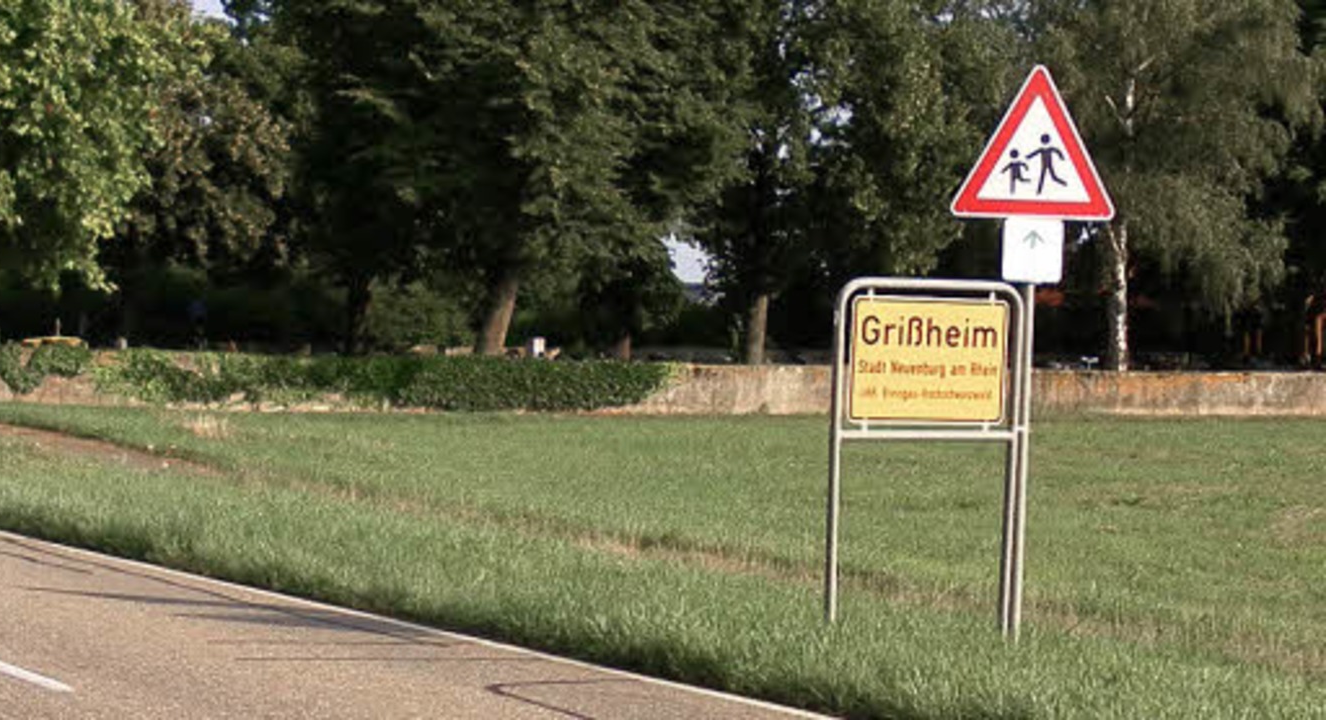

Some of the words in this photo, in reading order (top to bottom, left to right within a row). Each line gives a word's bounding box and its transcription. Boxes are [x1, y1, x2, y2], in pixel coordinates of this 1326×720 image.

[861, 315, 998, 348] Grißheim
[857, 359, 886, 374] Stadt
[890, 361, 946, 379] Neuenburg
[950, 364, 966, 376] am
[971, 362, 998, 377] Rhein
